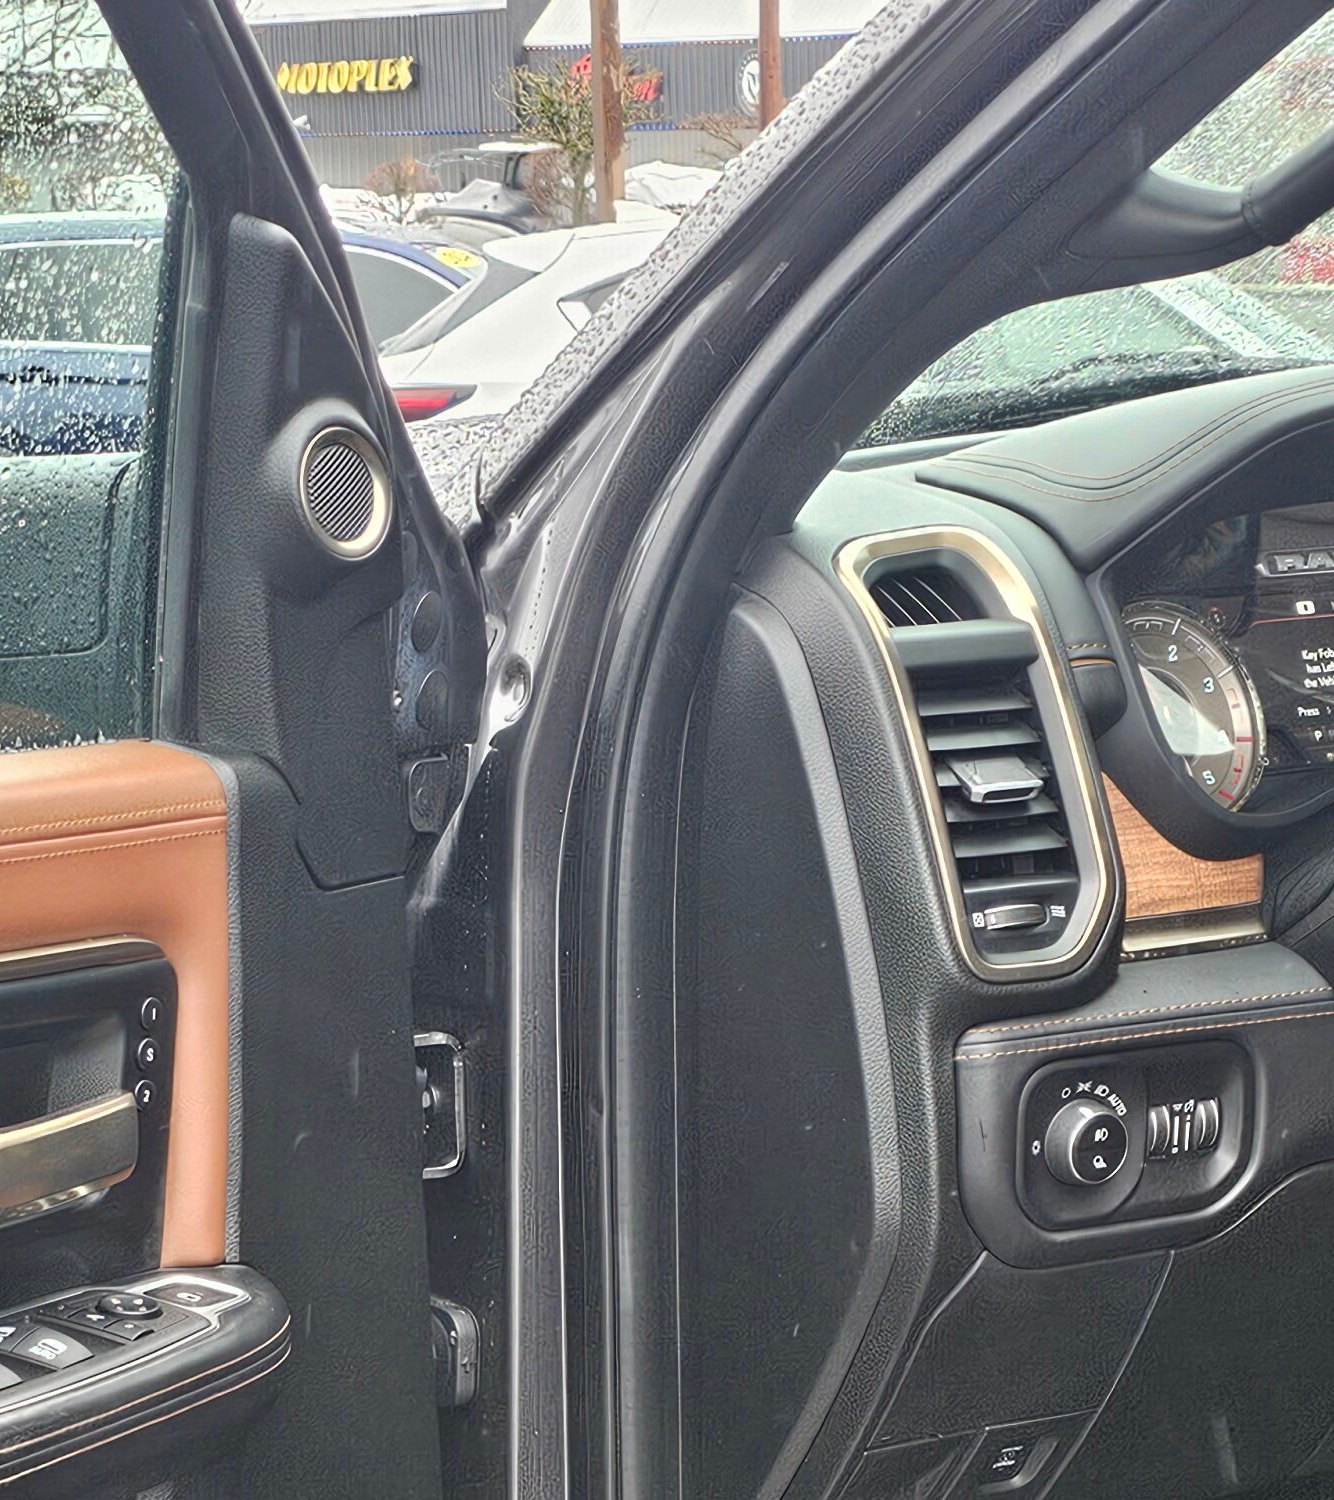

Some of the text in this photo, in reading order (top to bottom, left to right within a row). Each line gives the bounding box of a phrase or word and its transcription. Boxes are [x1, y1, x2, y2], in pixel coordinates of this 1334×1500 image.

[277, 55, 414, 95] MOTOPLEX
[1168, 645, 1179, 662] 2
[1202, 677, 1215, 693] 3
[1202, 770, 1216, 786] 5
[146, 1047, 154, 1062] S
[143, 1089, 151, 1103] 2
[1107, 1094, 1127, 1117] AUTO
